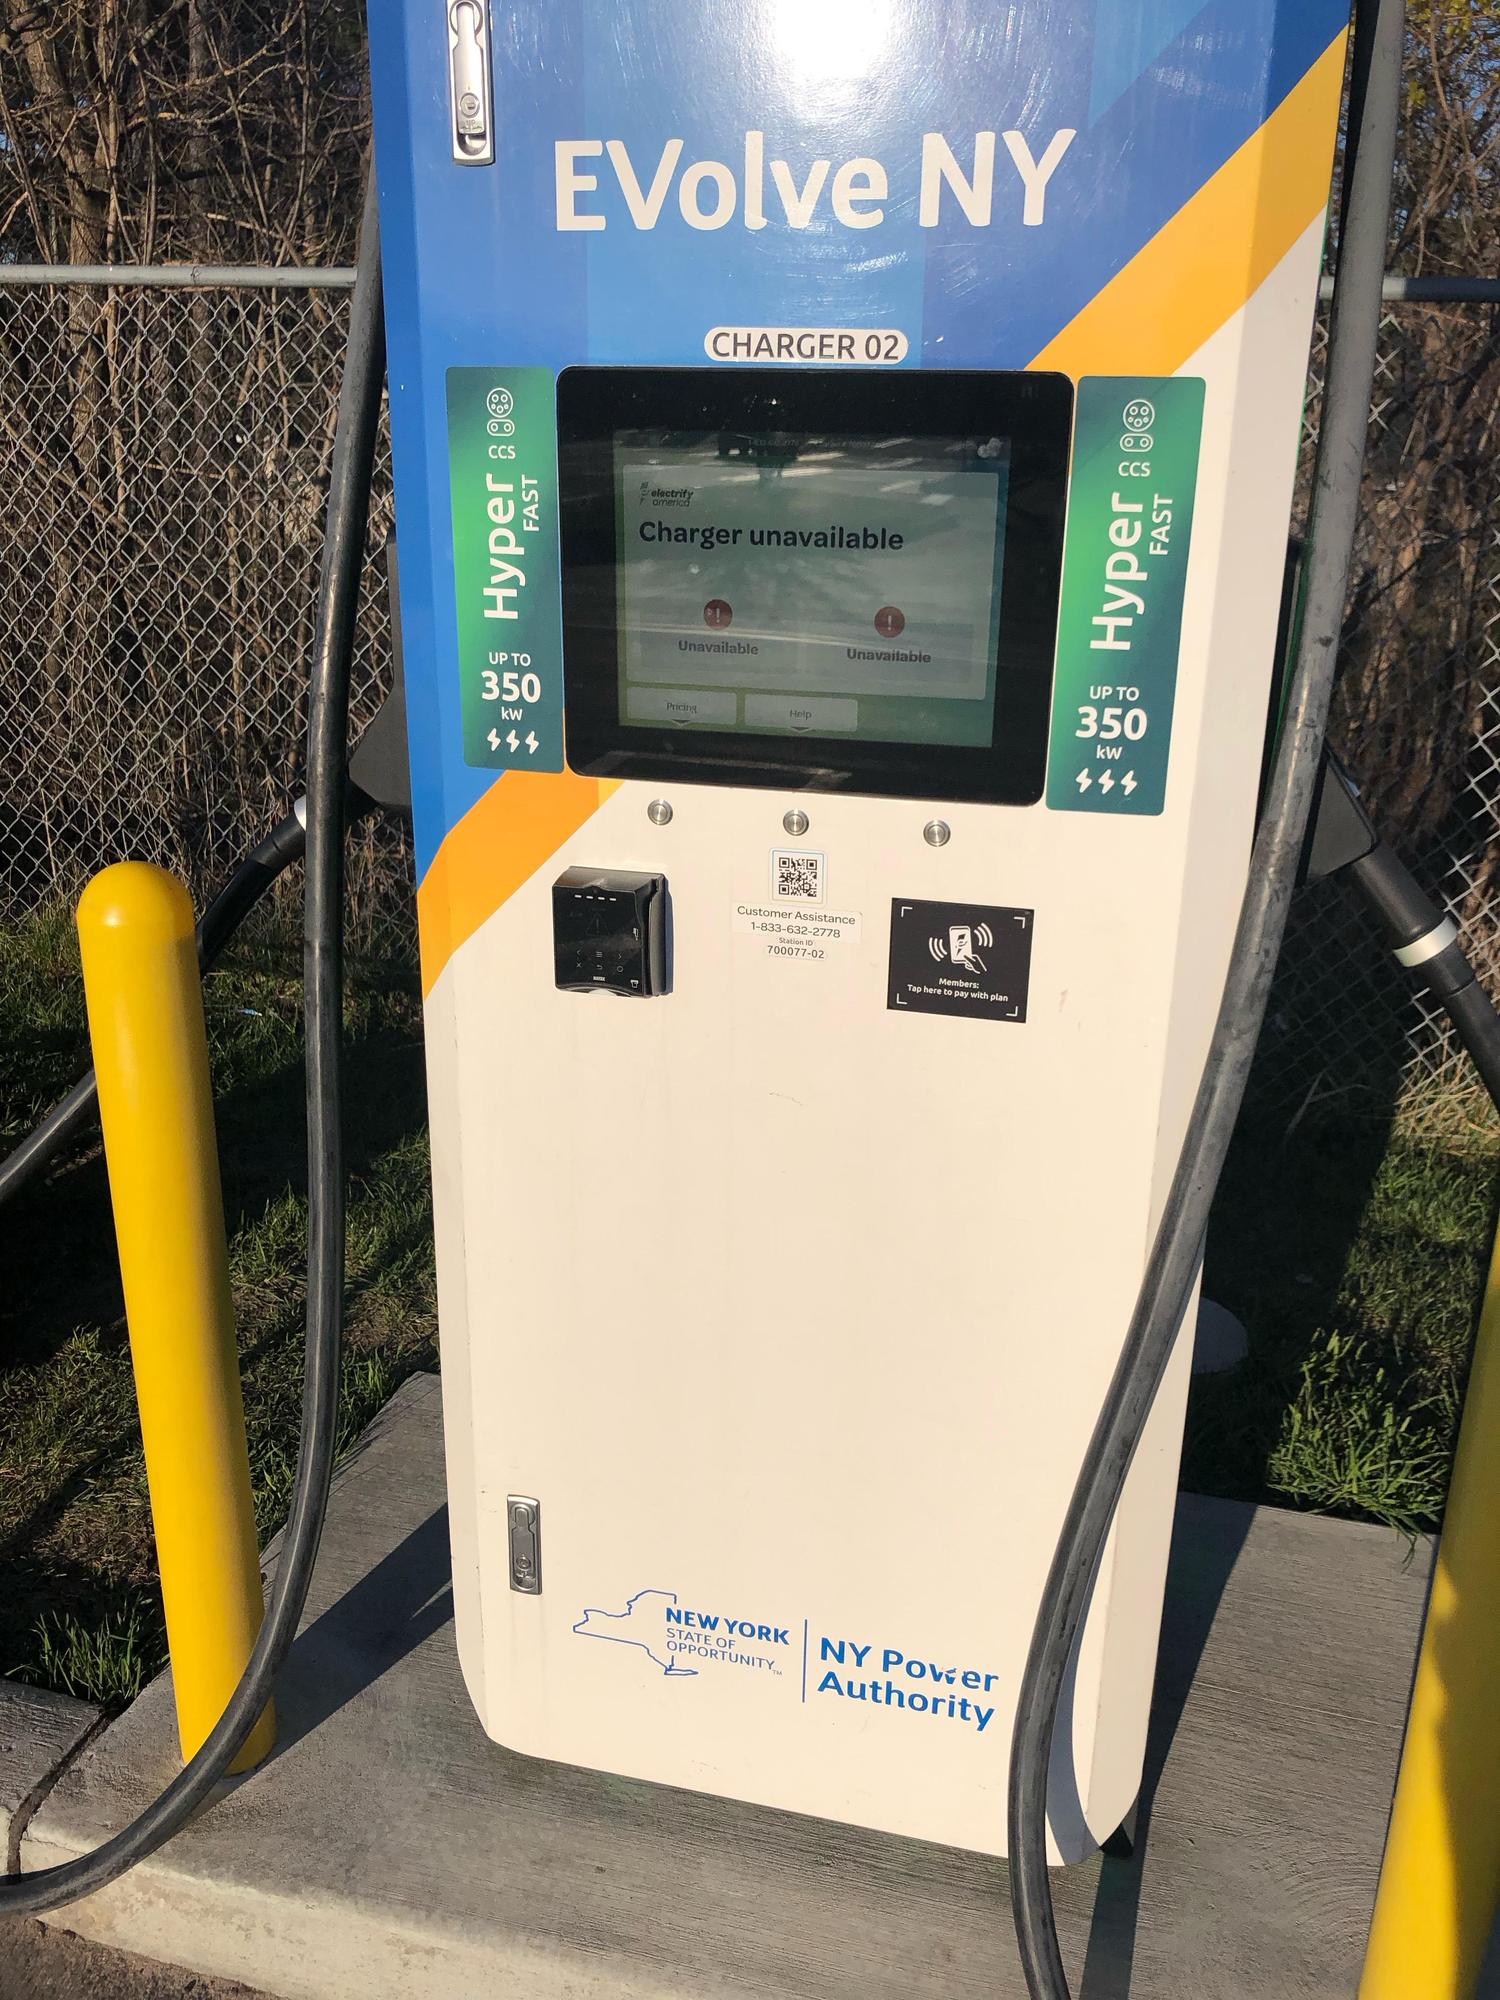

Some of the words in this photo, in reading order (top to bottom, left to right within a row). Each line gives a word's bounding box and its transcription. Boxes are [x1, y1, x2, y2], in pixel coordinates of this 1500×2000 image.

[555, 130, 888, 233] EVolve
[920, 128, 1077, 229] NY
[712, 332, 856, 360] CHARGER
[864, 334, 899, 360] 02
[488, 445, 516, 460] CCS
[1118, 461, 1151, 478] CCS
[521, 474, 540, 532] FAST
[651, 488, 694, 500] electrify
[1149, 493, 1173, 556] FAST
[639, 521, 743, 550] Charger
[750, 526, 904, 550] unavailable
[483, 473, 526, 620] Hyper
[1090, 492, 1149, 651] Hyper
[678, 640, 759, 656] Unavailable
[847, 648, 931, 664] Unavailable
[488, 652, 509, 666] UP
[511, 653, 531, 667] TO
[481, 670, 541, 704] 350
[1089, 685, 1113, 700] UP
[1115, 686, 1139, 702] TO
[501, 706, 523, 721] kW
[666, 702, 698, 715] Pricing
[789, 709, 812, 720] Help
[1075, 706, 1148, 742] 350
[1096, 744, 1123, 760] kW
[737, 905, 793, 919] Customer
[795, 911, 856, 925] Assistance
[750, 922, 841, 938] 1-833-632-2778
[778, 937, 804, 946] Station
[767, 945, 825, 959] 700077-02
[938, 978, 980, 989] Members:
[907, 984, 922, 993] Tap
[923, 985, 942, 995] here
[943, 988, 953, 996] to
[954, 990, 970, 999] pay
[970, 991, 989, 1000] with
[990, 993, 1009, 1002] plan
[665, 1607, 720, 1631] NEW
[723, 1617, 790, 1646] YORK
[666, 1627, 712, 1646] STATE
[716, 1637, 737, 1650] OF
[666, 1640, 776, 1670] OPPORTUNITY
[820, 1636, 873, 1668] NY
[882, 1648, 999, 1692] Power
[817, 1670, 996, 1732] Authority
